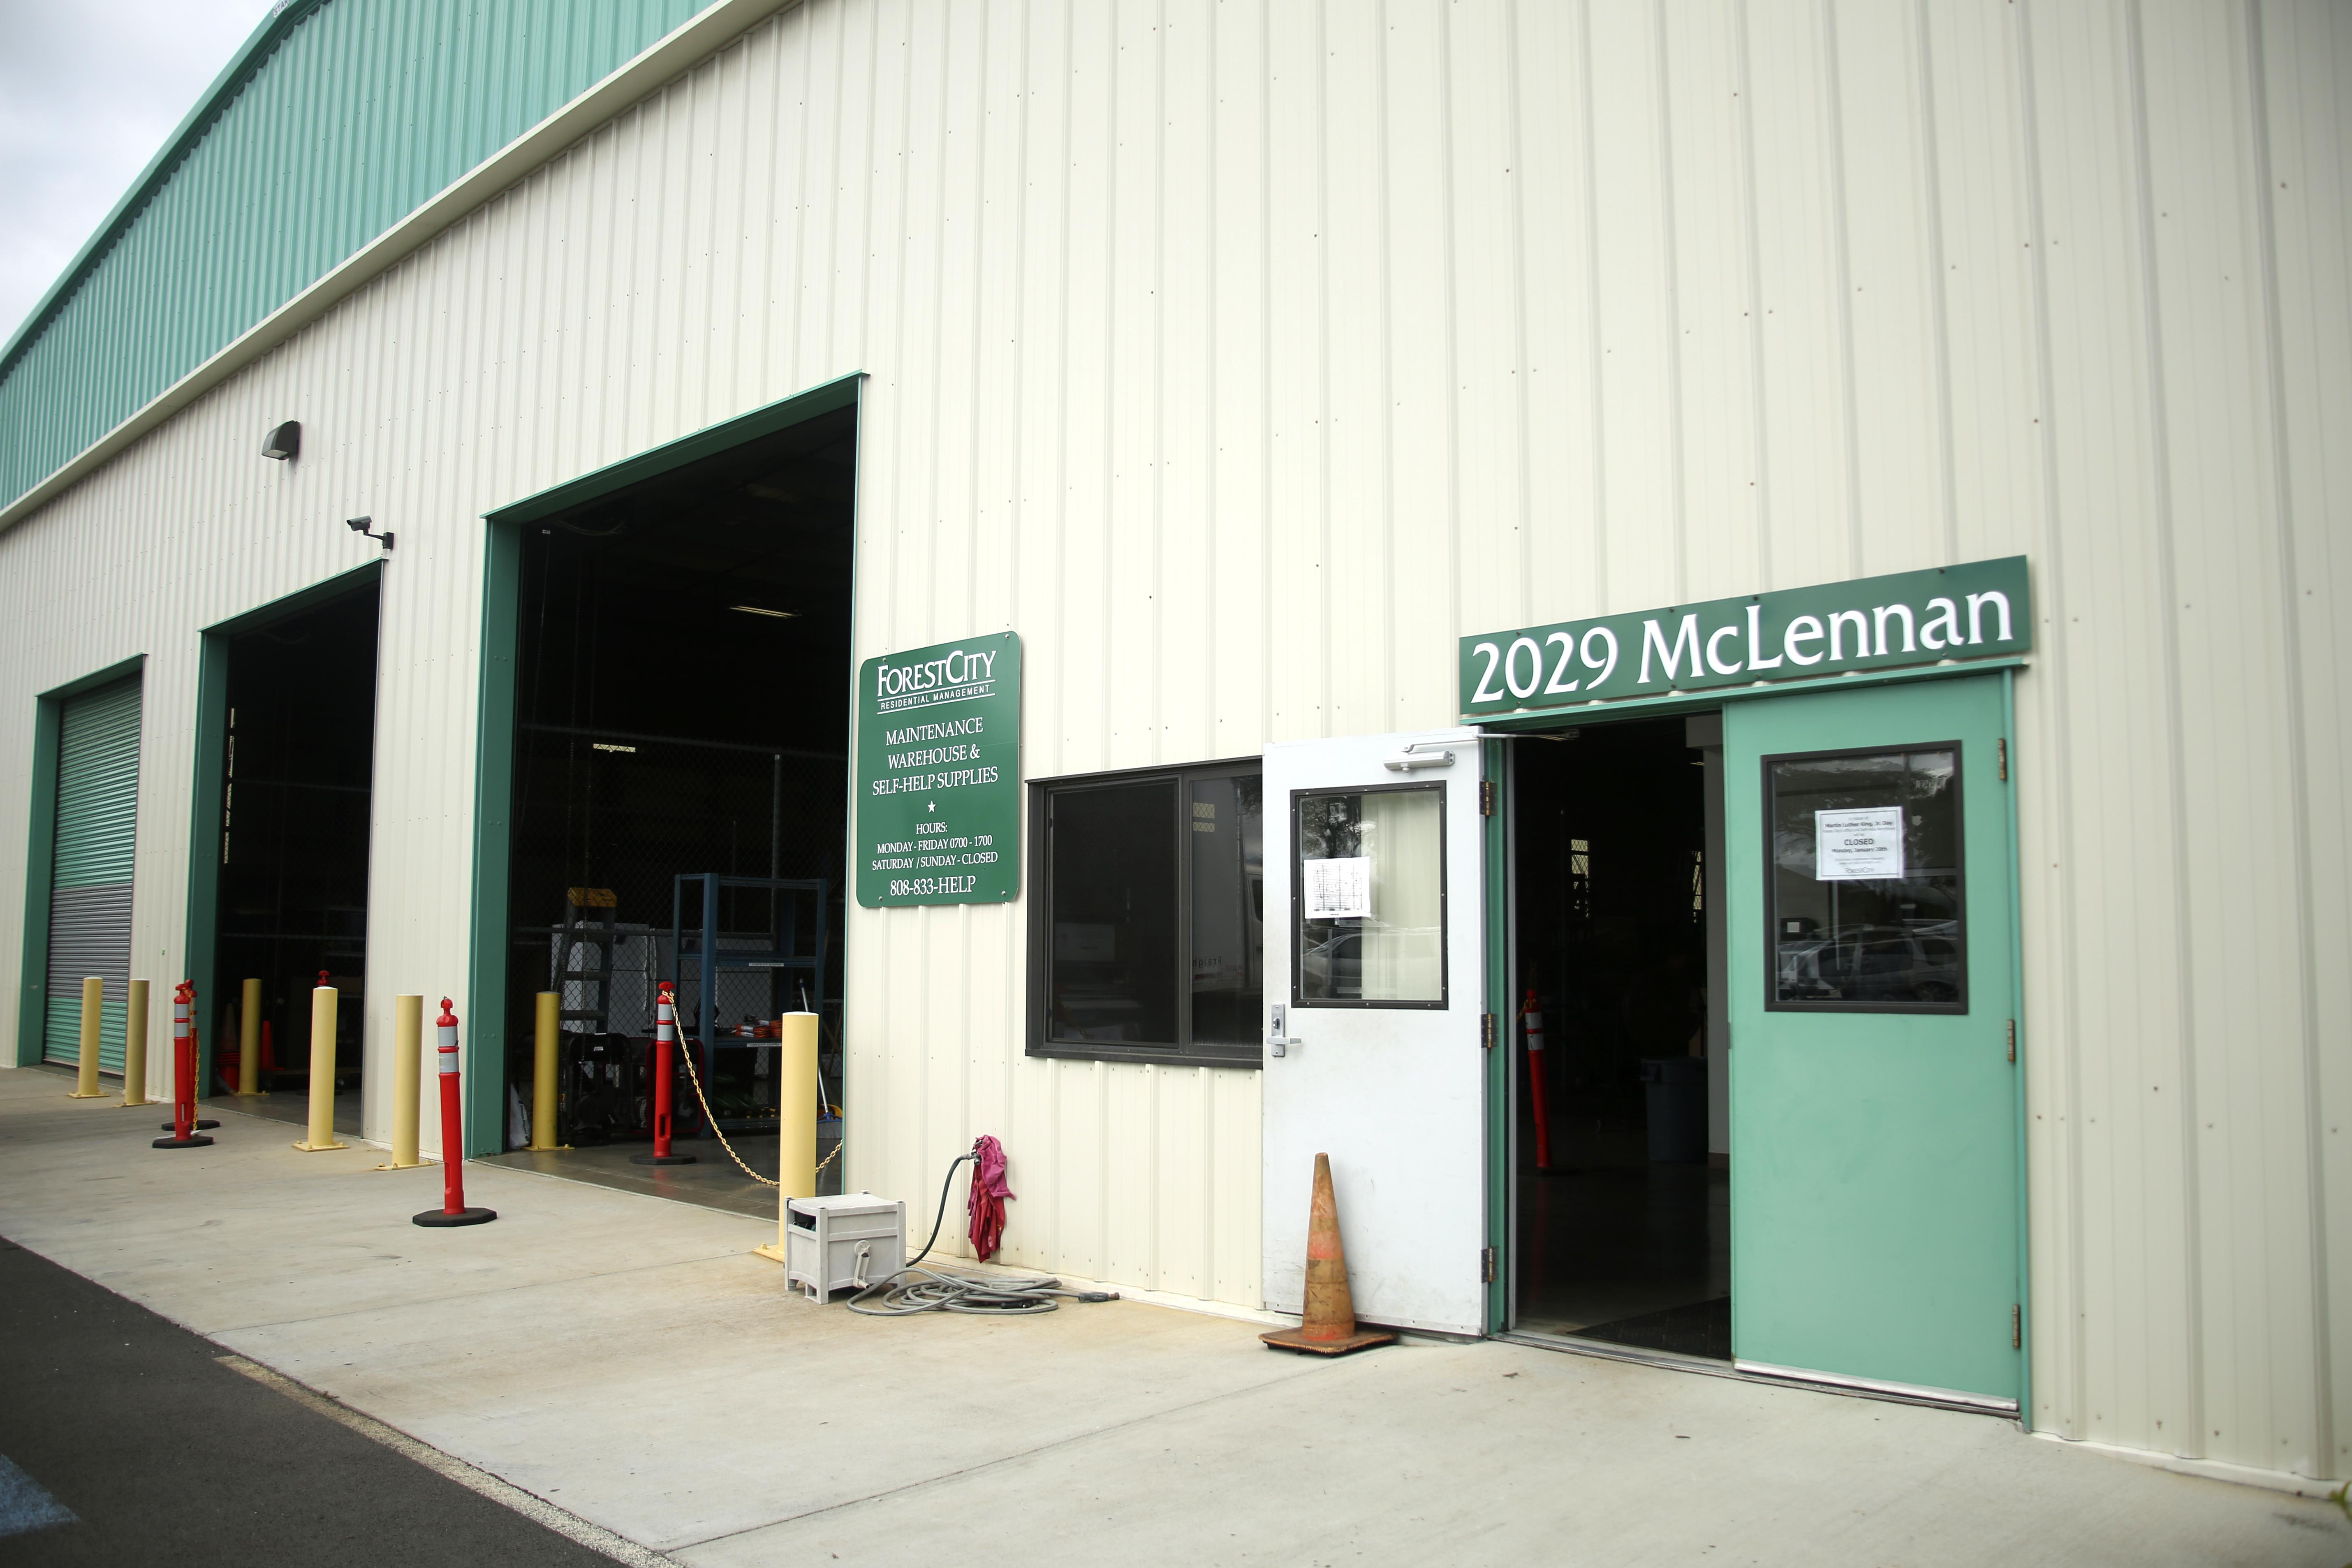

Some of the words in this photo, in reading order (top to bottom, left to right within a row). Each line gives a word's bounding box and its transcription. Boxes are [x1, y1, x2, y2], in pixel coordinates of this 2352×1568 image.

[1471, 627, 1618, 703] 2029
[1637, 591, 2012, 683] McLennan
[881, 695, 930, 710] RESIDENTIAL
[933, 684, 990, 701] MANAGEMENT
[886, 717, 983, 746] MAINTENANCE
[888, 744, 967, 769] WAREHOUSE
[970, 743, 980, 759] &
[873, 774, 935, 796] SELF-HELP
[937, 766, 998, 788] SUPPLIES
[916, 822, 948, 834] HOURS:
[950, 837, 968, 849] 0700
[974, 835, 992, 847] 1700
[872, 857, 914, 871] SATURDAY
[890, 875, 976, 896] 808-833-HELP
